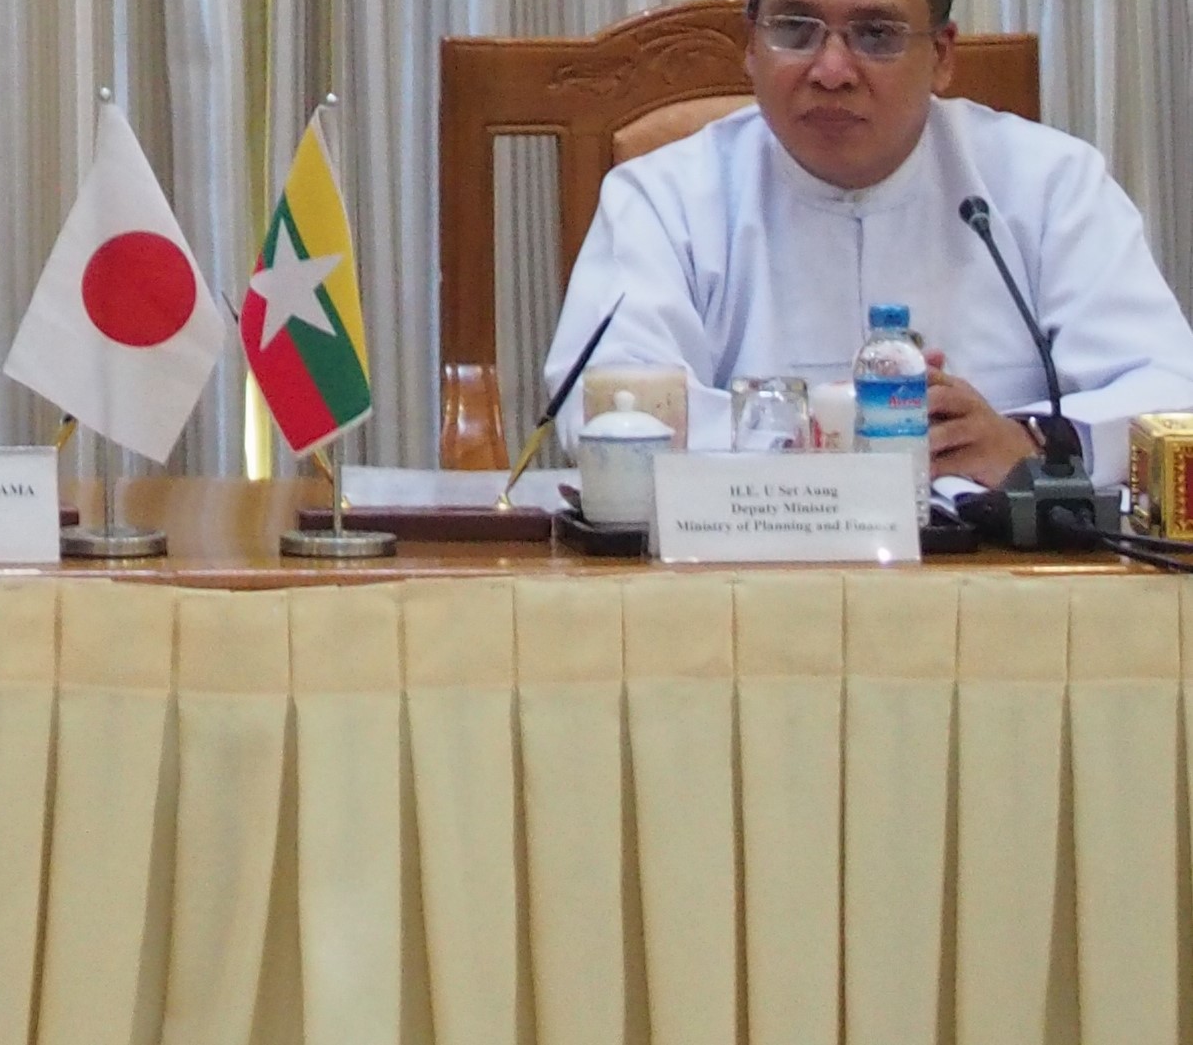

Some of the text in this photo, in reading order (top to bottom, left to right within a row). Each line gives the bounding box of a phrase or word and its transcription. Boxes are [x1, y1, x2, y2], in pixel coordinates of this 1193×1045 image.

[731, 502, 838, 516] Deputy Minister
[675, 520, 897, 534] Ministry of Planning and Finae
